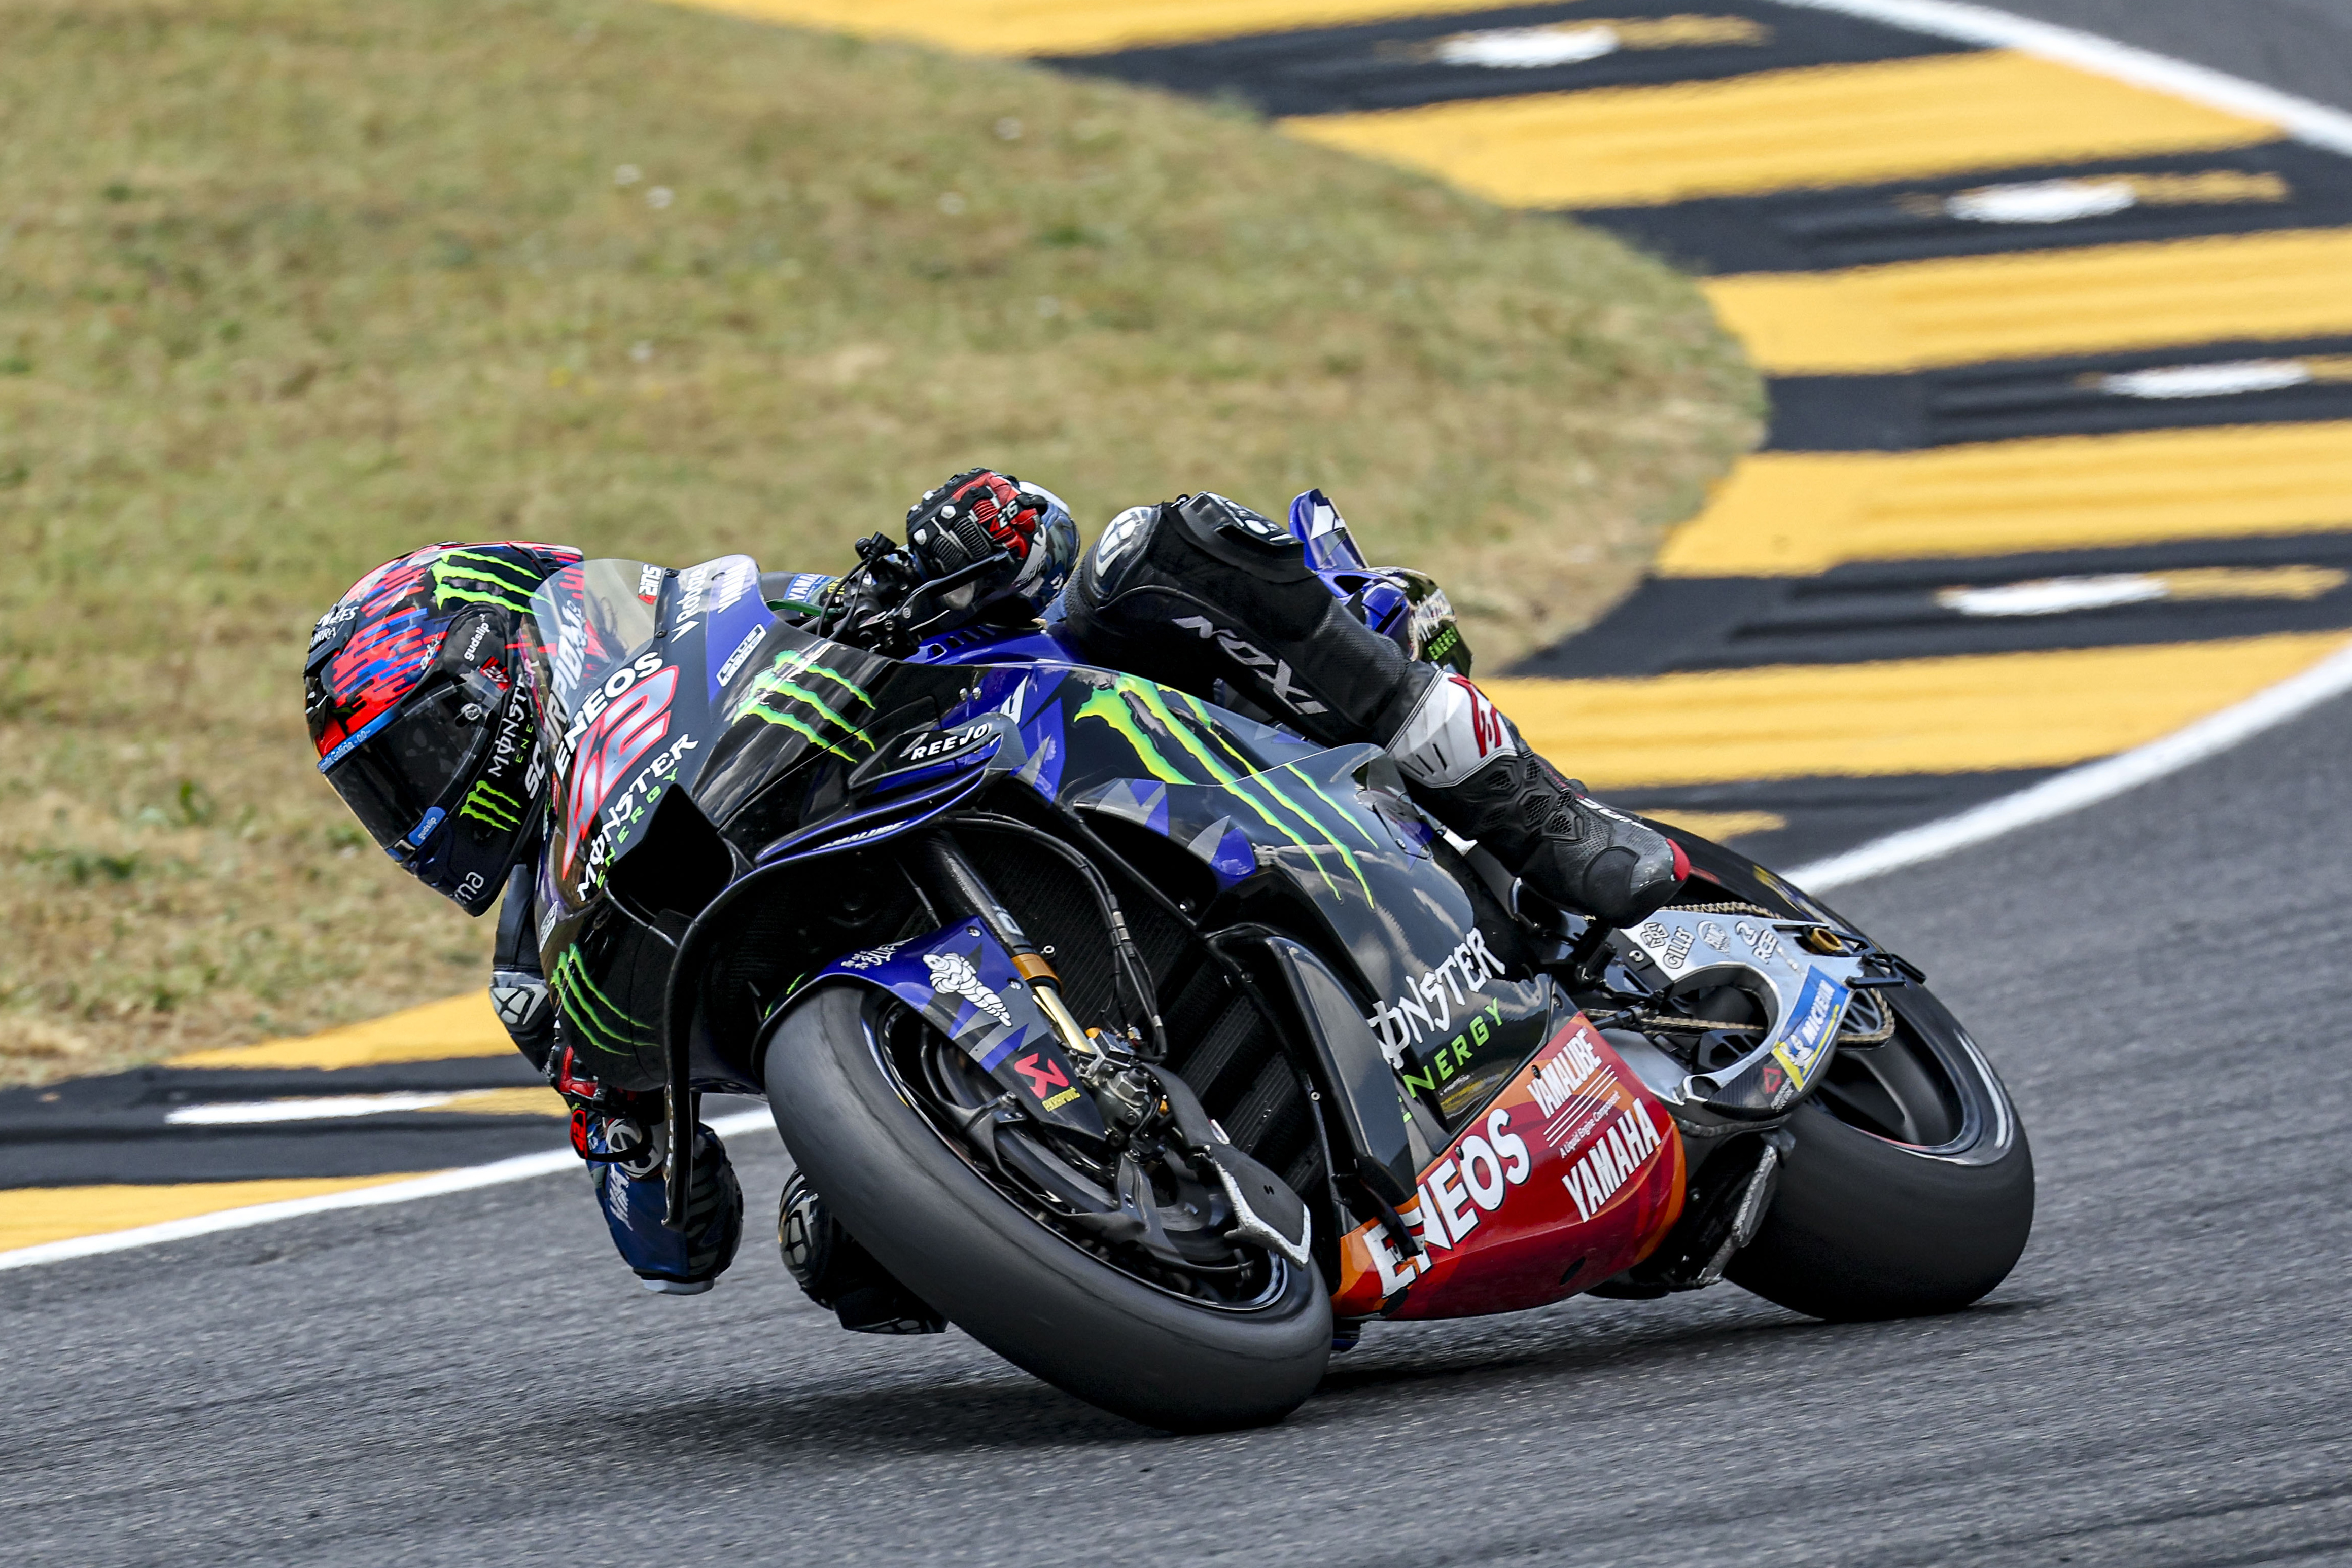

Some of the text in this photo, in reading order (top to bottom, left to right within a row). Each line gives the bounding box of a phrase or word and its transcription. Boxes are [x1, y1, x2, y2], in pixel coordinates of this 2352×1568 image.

[464, 622, 490, 661] gudslip
[555, 652, 663, 780] ENEOS
[577, 734, 699, 901] MONSTER
[596, 767, 678, 889] ENERGY
[1368, 927, 1505, 1070] ONSTER
[1398, 996, 1503, 1123] NERGY
[1526, 1027, 1603, 1119] YAMALUBE
[1561, 1097, 1661, 1223] YAMAHA
